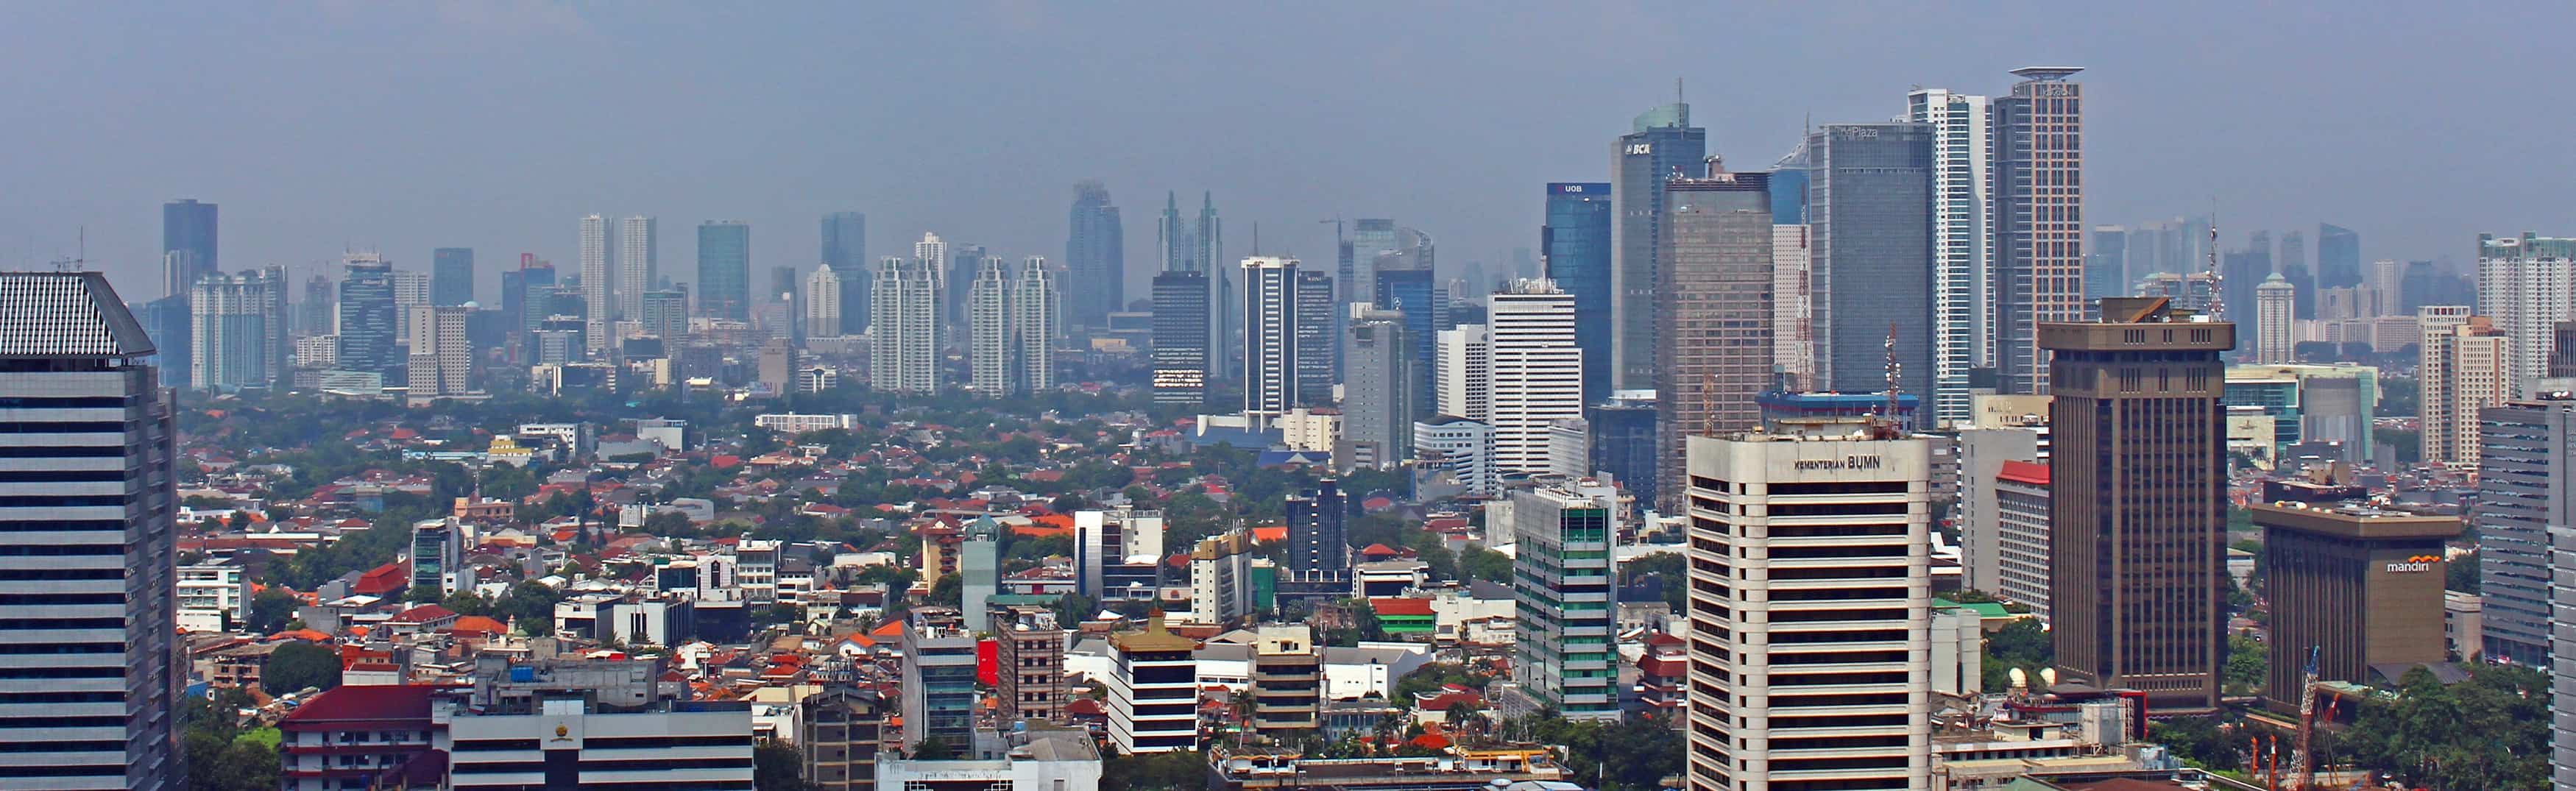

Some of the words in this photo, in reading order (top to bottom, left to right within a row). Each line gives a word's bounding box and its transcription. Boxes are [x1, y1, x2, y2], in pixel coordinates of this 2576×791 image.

[1853, 126, 1878, 137] Plaza
[1633, 143, 1650, 155] BCA
[1565, 185, 1582, 193] UOB
[1794, 460, 1845, 470] KEMENTERIAN
[1848, 455, 1880, 469] BUMN
[2387, 561, 2429, 572] mandiri
